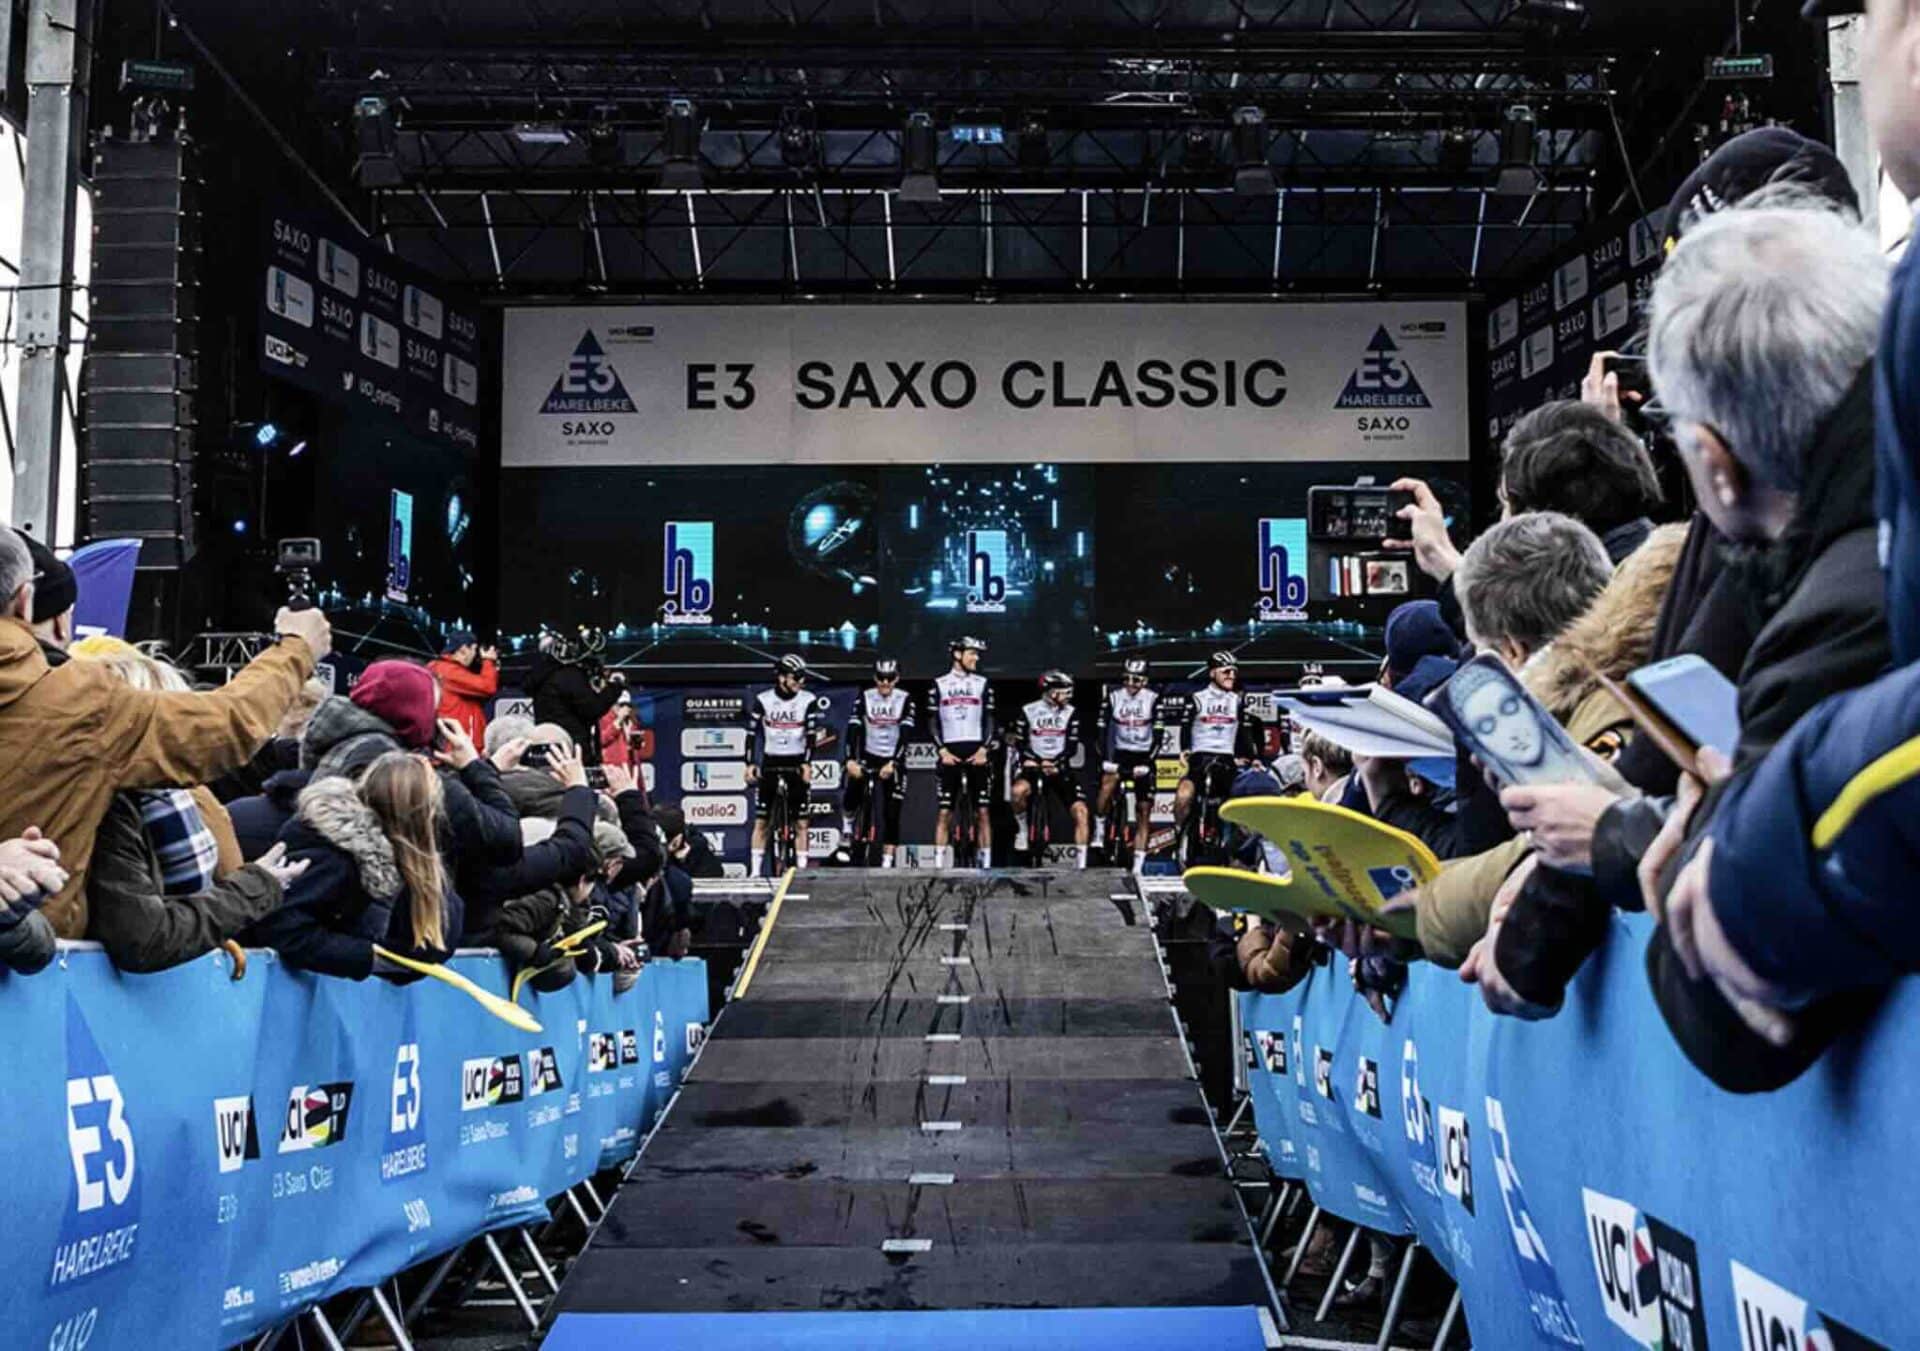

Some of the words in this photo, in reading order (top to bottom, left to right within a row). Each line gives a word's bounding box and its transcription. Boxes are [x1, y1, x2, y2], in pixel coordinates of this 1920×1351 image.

[273, 219, 311, 254] SAXO
[1593, 236, 1623, 269] SAXO
[367, 268, 399, 300] SAXO
[320, 297, 355, 329] SAXO
[1558, 310, 1586, 341] SAXO
[406, 339, 439, 369] SAXO
[1356, 351, 1410, 388] E3
[1490, 350, 1517, 380] SAXO
[562, 355, 616, 393] E3
[686, 363, 756, 410] E3
[796, 361, 978, 410] SAXO
[1001, 359, 1288, 410] CLASSIC
[546, 399, 634, 412] HARELBEKE
[1342, 393, 1425, 406] HARELBEKE
[562, 421, 615, 436] SAXO
[1358, 416, 1410, 431] SAXO
[686, 699, 743, 708] QUARTIER
[770, 711, 797, 722] UAE
[691, 803, 737, 817] radio2
[391, 1043, 421, 1134] E3
[465, 1067, 488, 1101] UCI
[67, 1075, 135, 1212] E3
[1592, 1214, 1638, 1318] UCI
